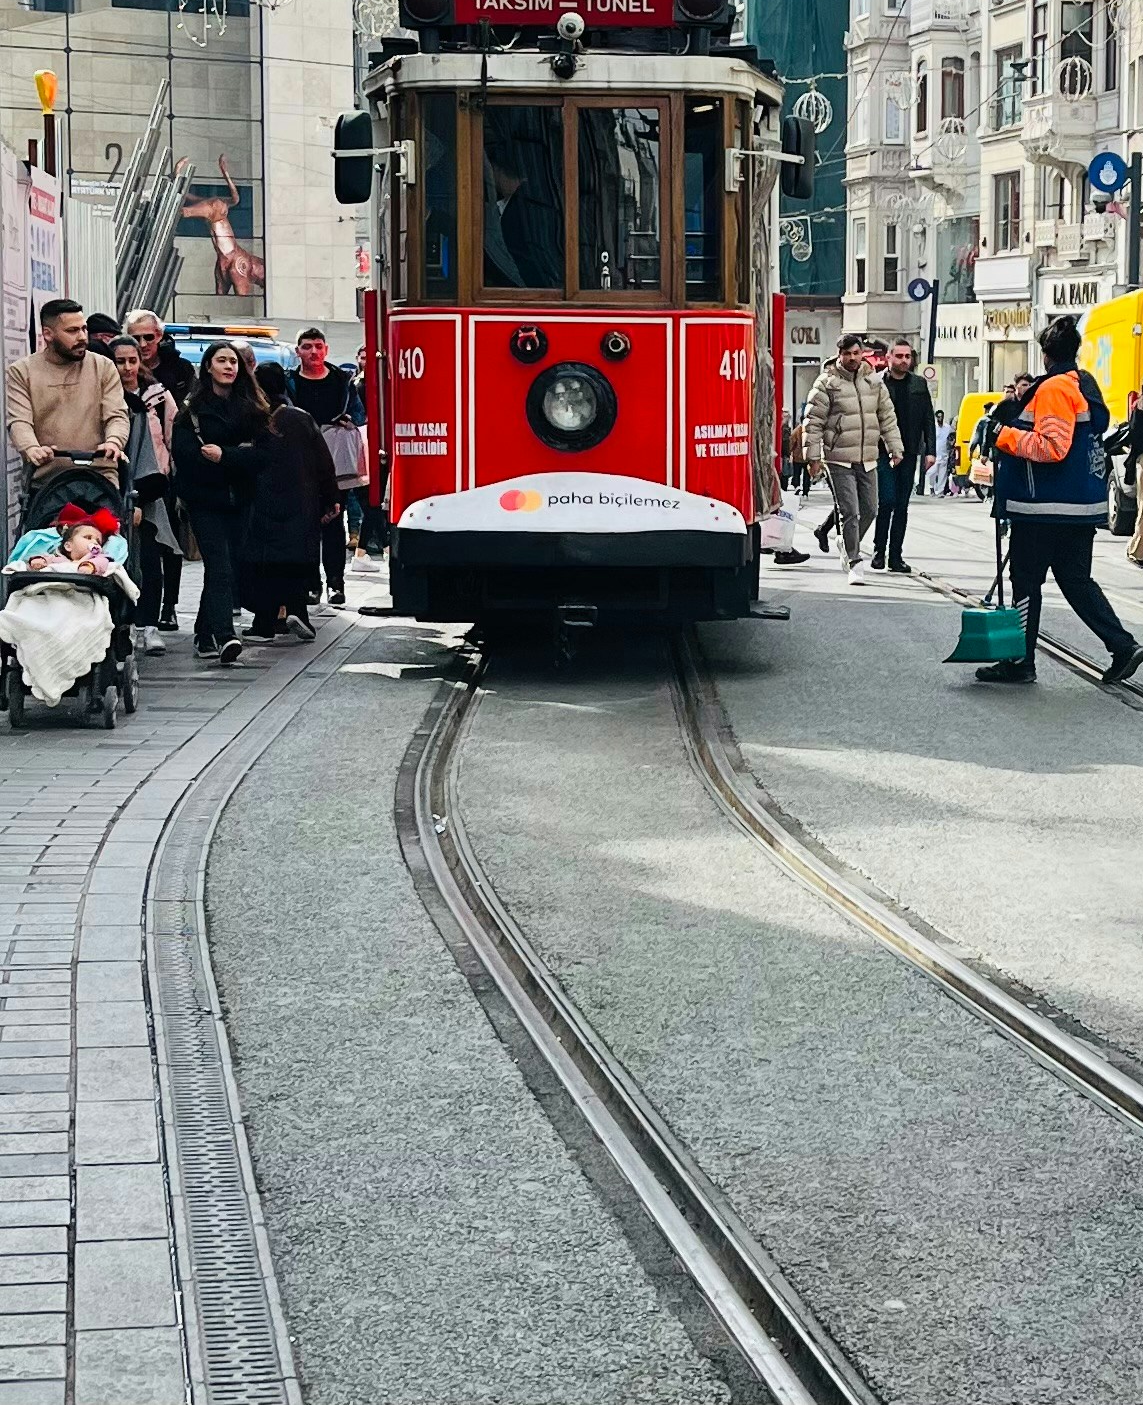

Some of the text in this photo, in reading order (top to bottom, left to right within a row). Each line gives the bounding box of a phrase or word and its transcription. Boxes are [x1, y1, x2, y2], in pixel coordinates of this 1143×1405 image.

[398, 346, 425, 380] 410
[719, 348, 747, 381] 410
[418, 423, 448, 436] YASAK
[694, 424, 732, 440] ASILMAK
[695, 443, 707, 457] VE
[548, 492, 681, 510] paha biçilemez
